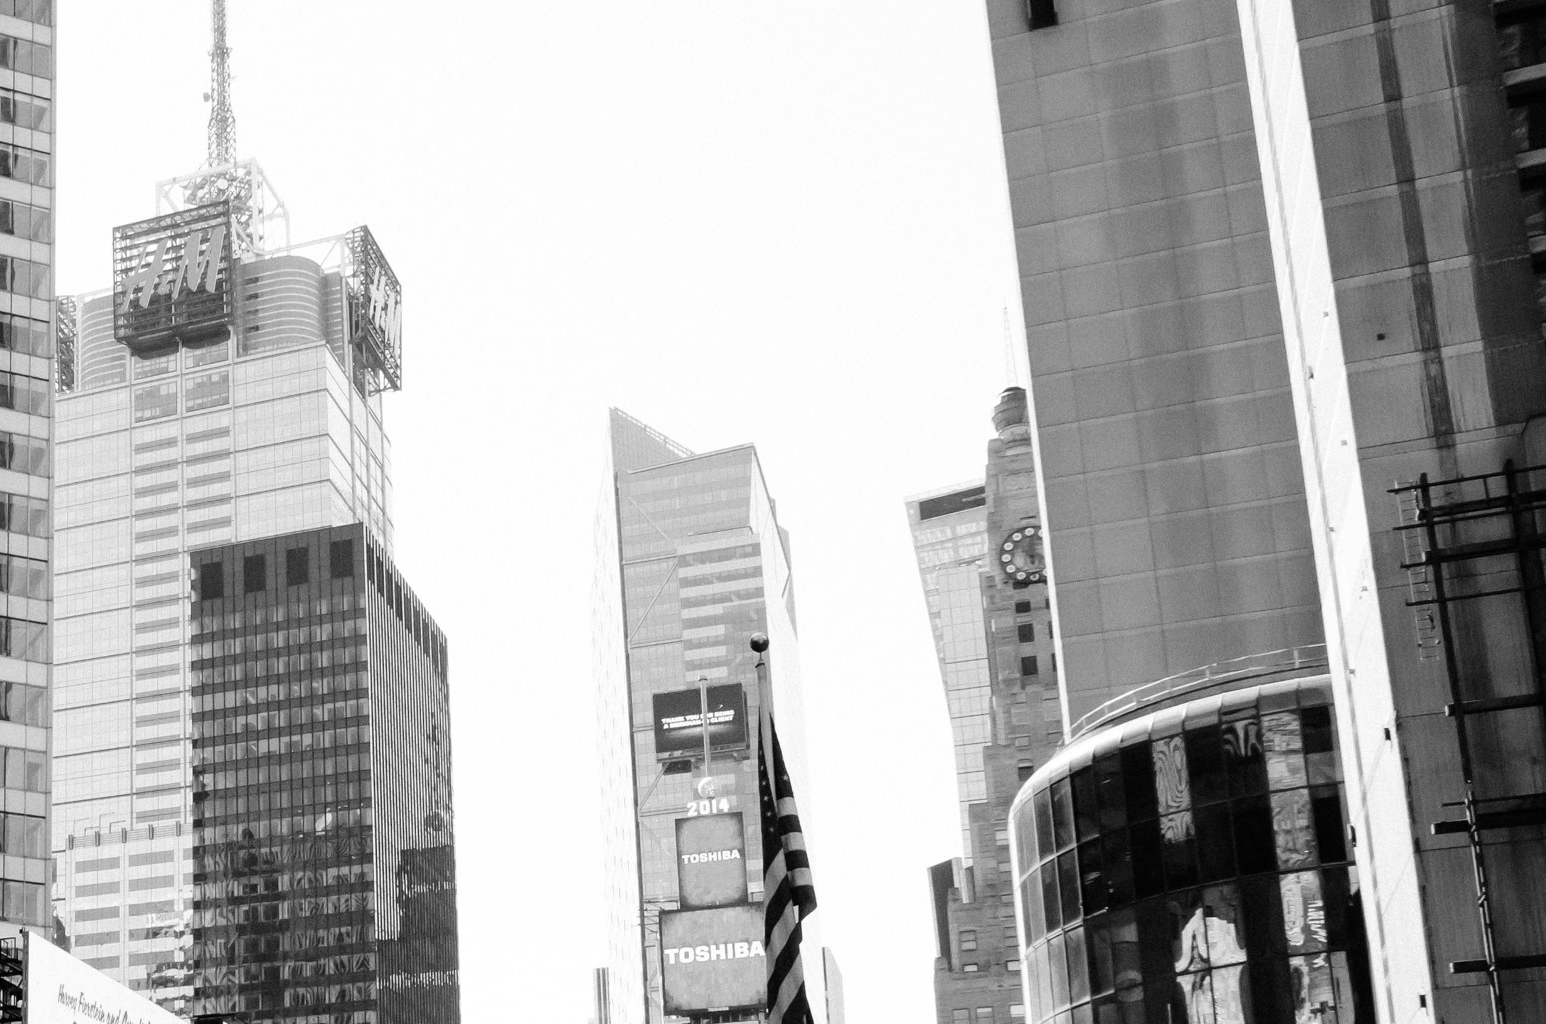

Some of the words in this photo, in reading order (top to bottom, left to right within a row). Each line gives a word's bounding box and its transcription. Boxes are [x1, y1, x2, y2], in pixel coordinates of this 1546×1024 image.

[686, 797, 729, 817] 2014
[682, 849, 740, 865] TOSHIBA
[664, 940, 766, 965] TOSHIBA
[57, 983, 78, 1015] Harvey
